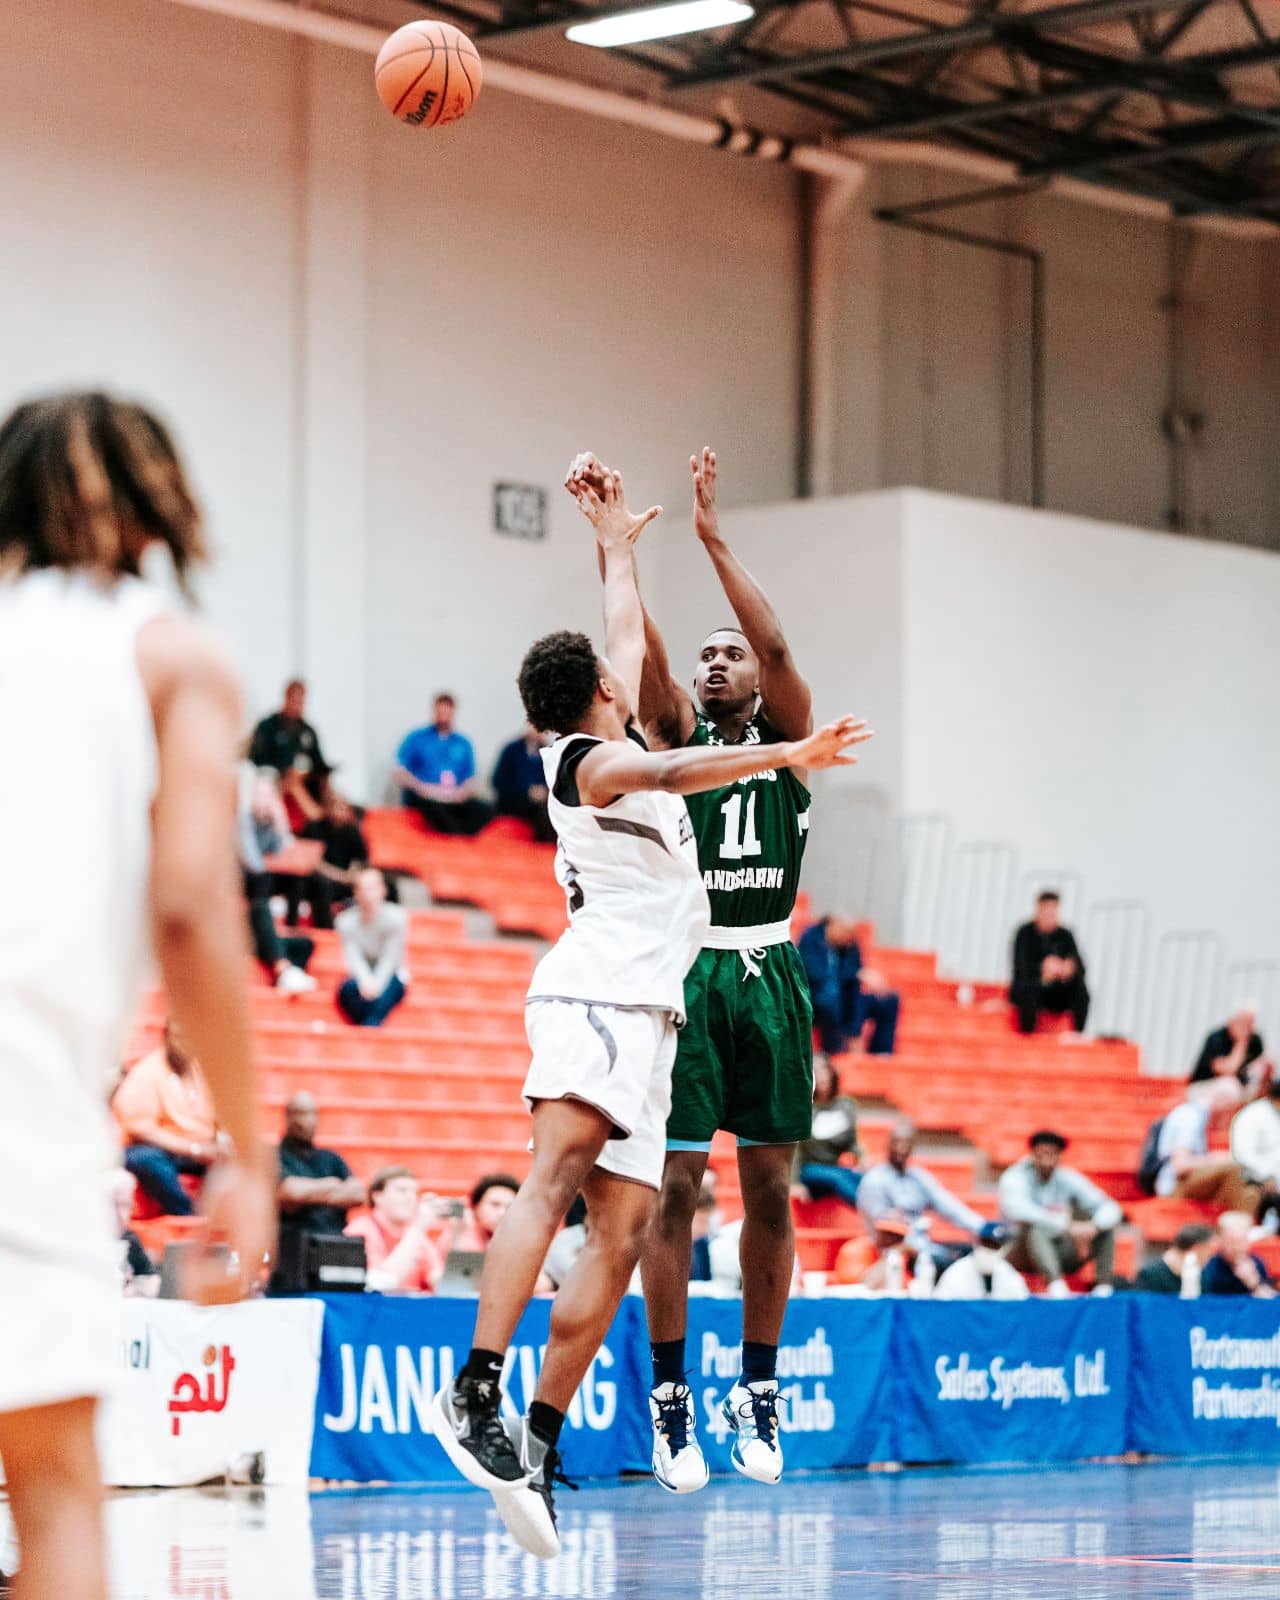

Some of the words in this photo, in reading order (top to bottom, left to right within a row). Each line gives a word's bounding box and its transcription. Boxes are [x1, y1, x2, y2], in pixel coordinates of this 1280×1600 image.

[718, 790, 762, 860] 11
[1190, 1326, 1280, 1369] Portsmout
[935, 1352, 989, 1400] Sales
[777, 1382, 835, 1432] Club
